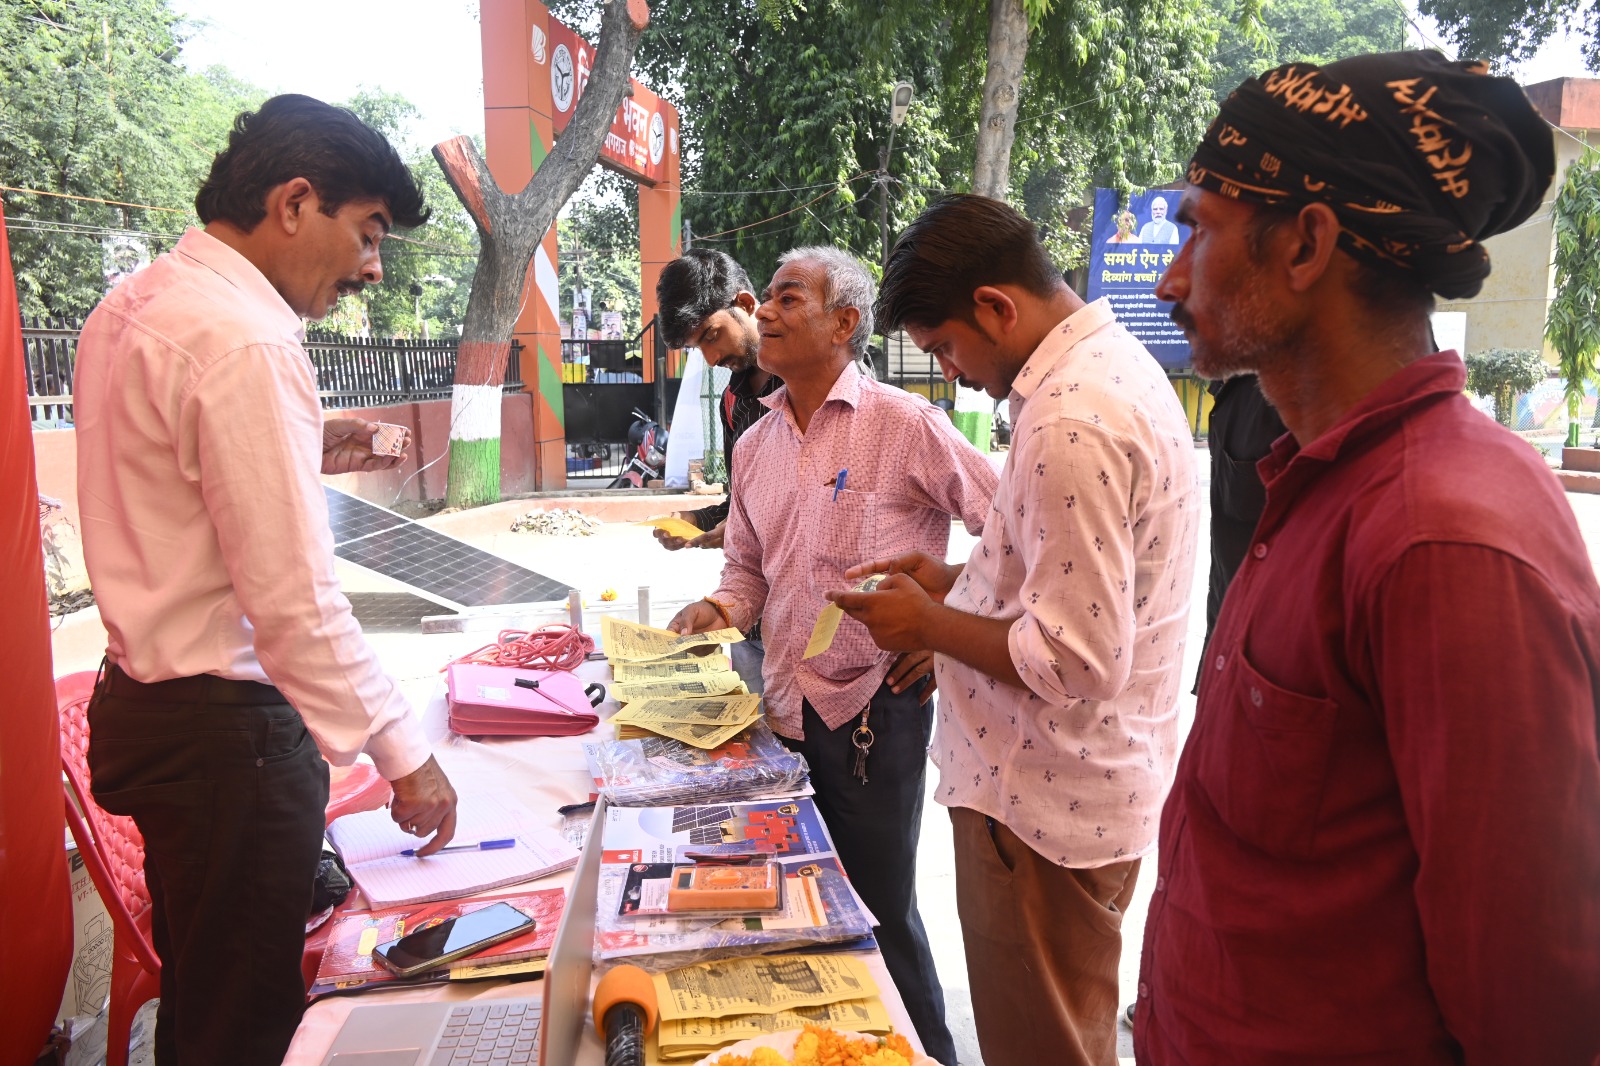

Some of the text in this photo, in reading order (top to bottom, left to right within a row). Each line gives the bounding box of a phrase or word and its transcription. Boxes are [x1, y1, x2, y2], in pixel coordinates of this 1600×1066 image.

[623, 96, 649, 141] भवन
[604, 131, 627, 157] यागराज
[1103, 249, 1174, 269] समर्थ ऐप से
[1101, 270, 1132, 283] दिव्यांग
[1134, 270, 1157, 283] बच्चों
